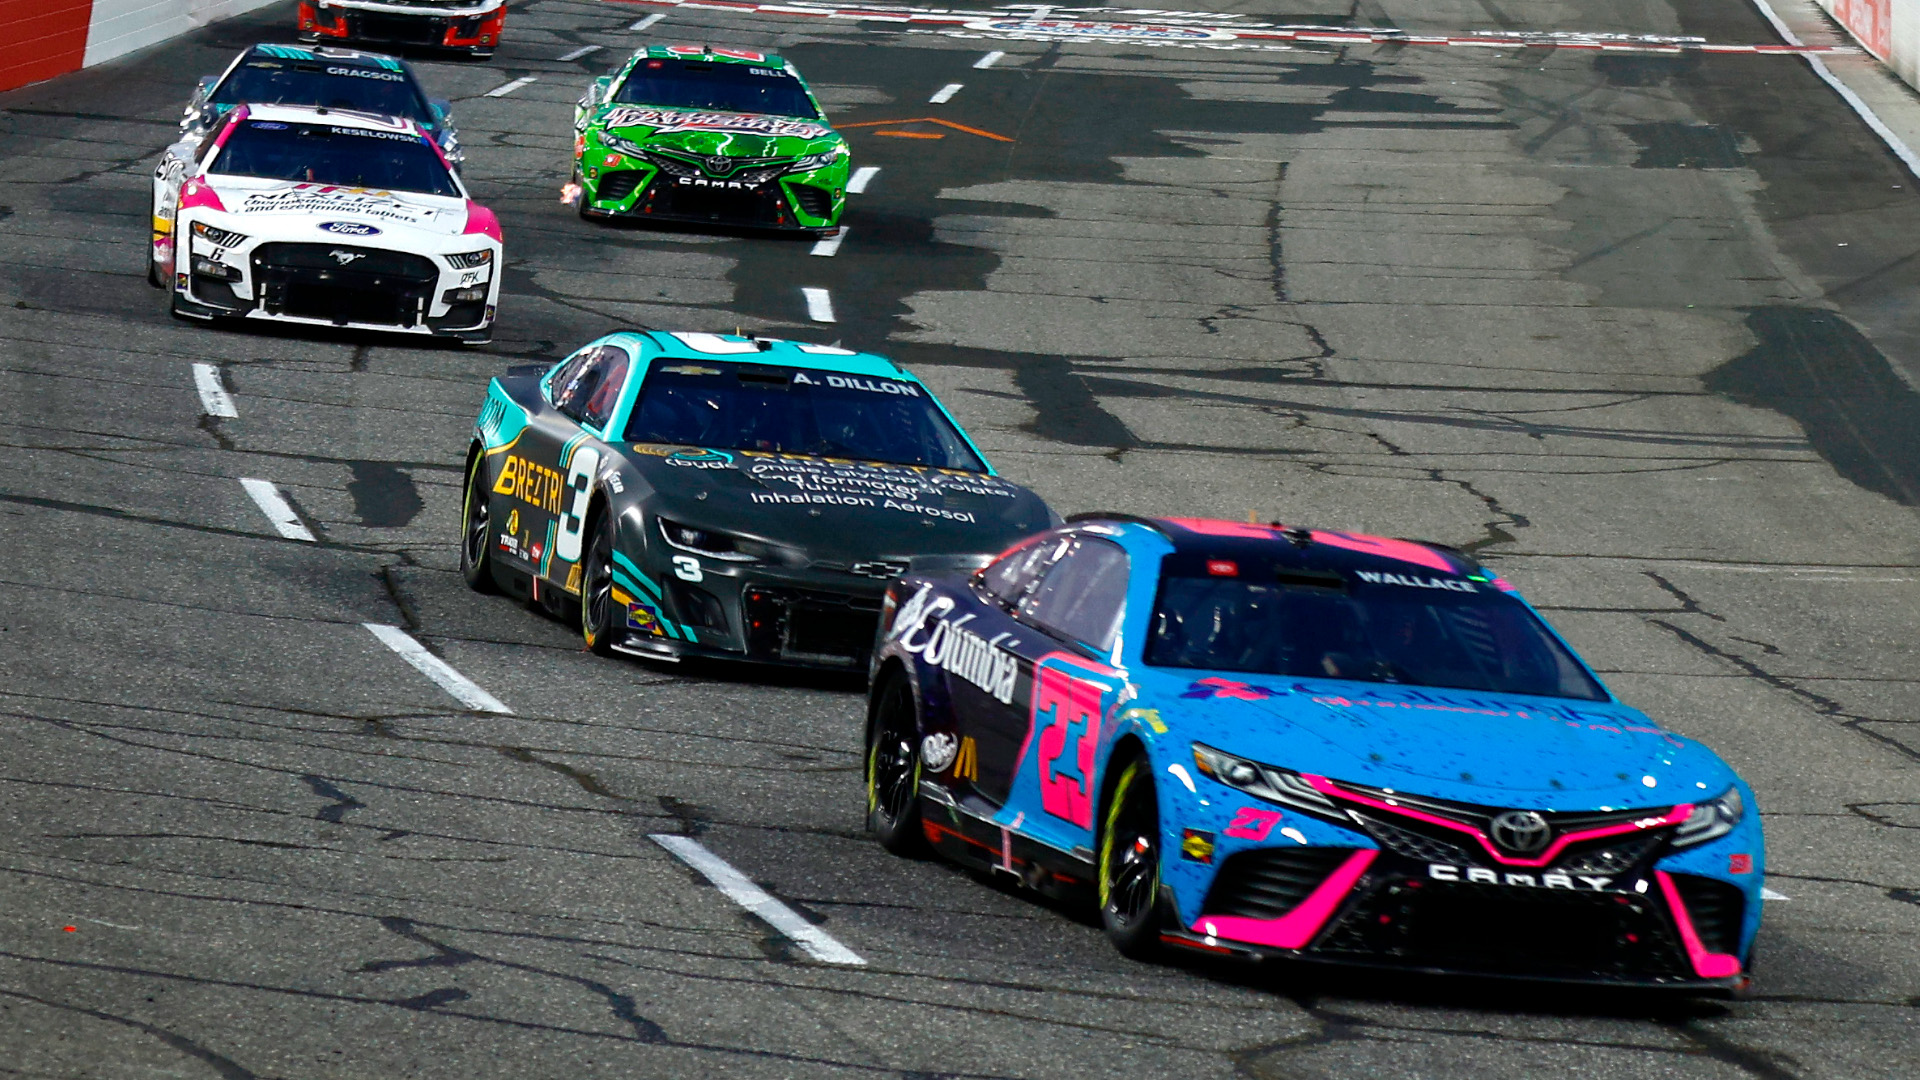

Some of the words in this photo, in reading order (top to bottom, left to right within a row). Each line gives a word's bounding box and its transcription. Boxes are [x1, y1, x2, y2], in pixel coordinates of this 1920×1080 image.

[326, 66, 405, 83] GRAGSON
[748, 67, 787, 78] BELL
[678, 177, 760, 190] CAMRY
[793, 372, 822, 386] A.
[826, 374, 919, 398] DILLON
[492, 455, 565, 516] BREZTRI
[555, 445, 600, 563] 3
[750, 491, 876, 508] Inhalation
[883, 498, 976, 525] Aerosol
[671, 554, 704, 583] 3
[1354, 569, 1480, 594] WALLACE
[1037, 666, 1103, 832] 23
[1428, 863, 1614, 893] CAMRY
